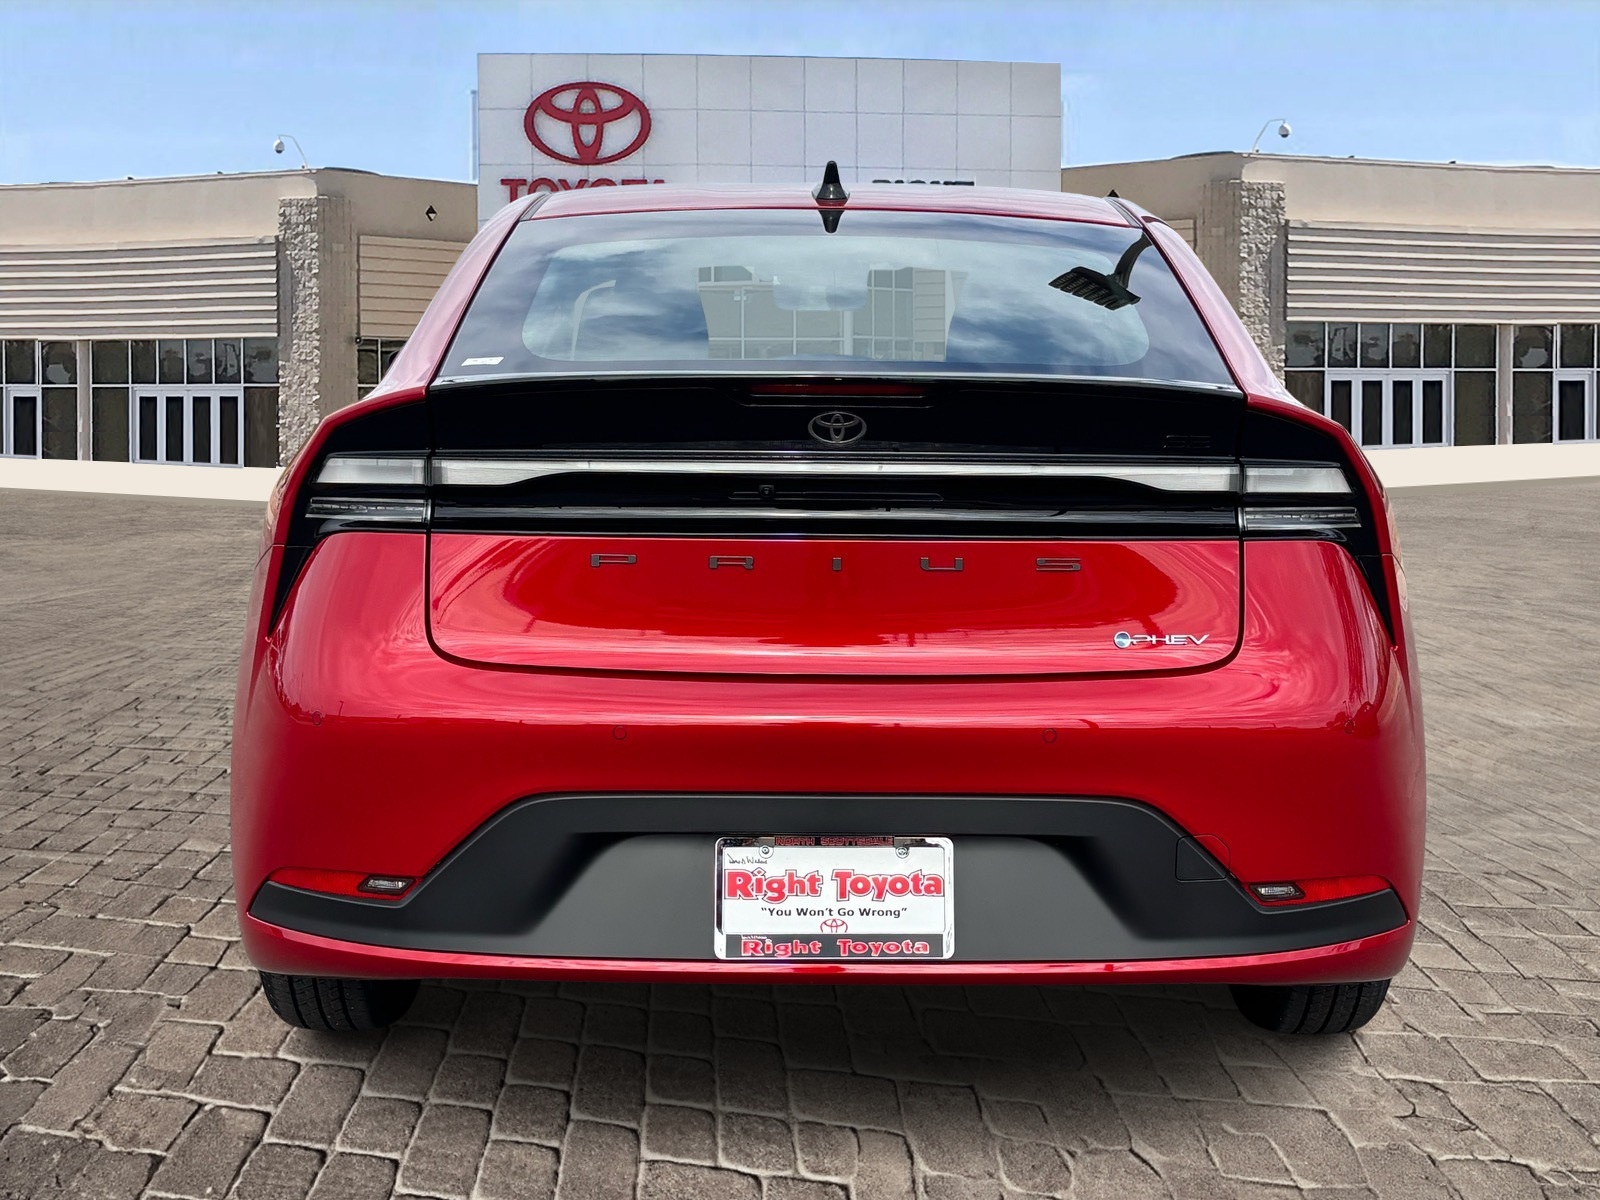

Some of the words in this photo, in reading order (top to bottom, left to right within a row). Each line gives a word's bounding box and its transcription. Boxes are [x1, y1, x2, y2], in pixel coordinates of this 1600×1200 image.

[591, 553, 1081, 572] PRIUS
[724, 867, 823, 904] Right
[831, 869, 945, 902] Toyota
[838, 907, 855, 917] Go
[741, 938, 822, 958] Right
[837, 939, 930, 956] Toyota
